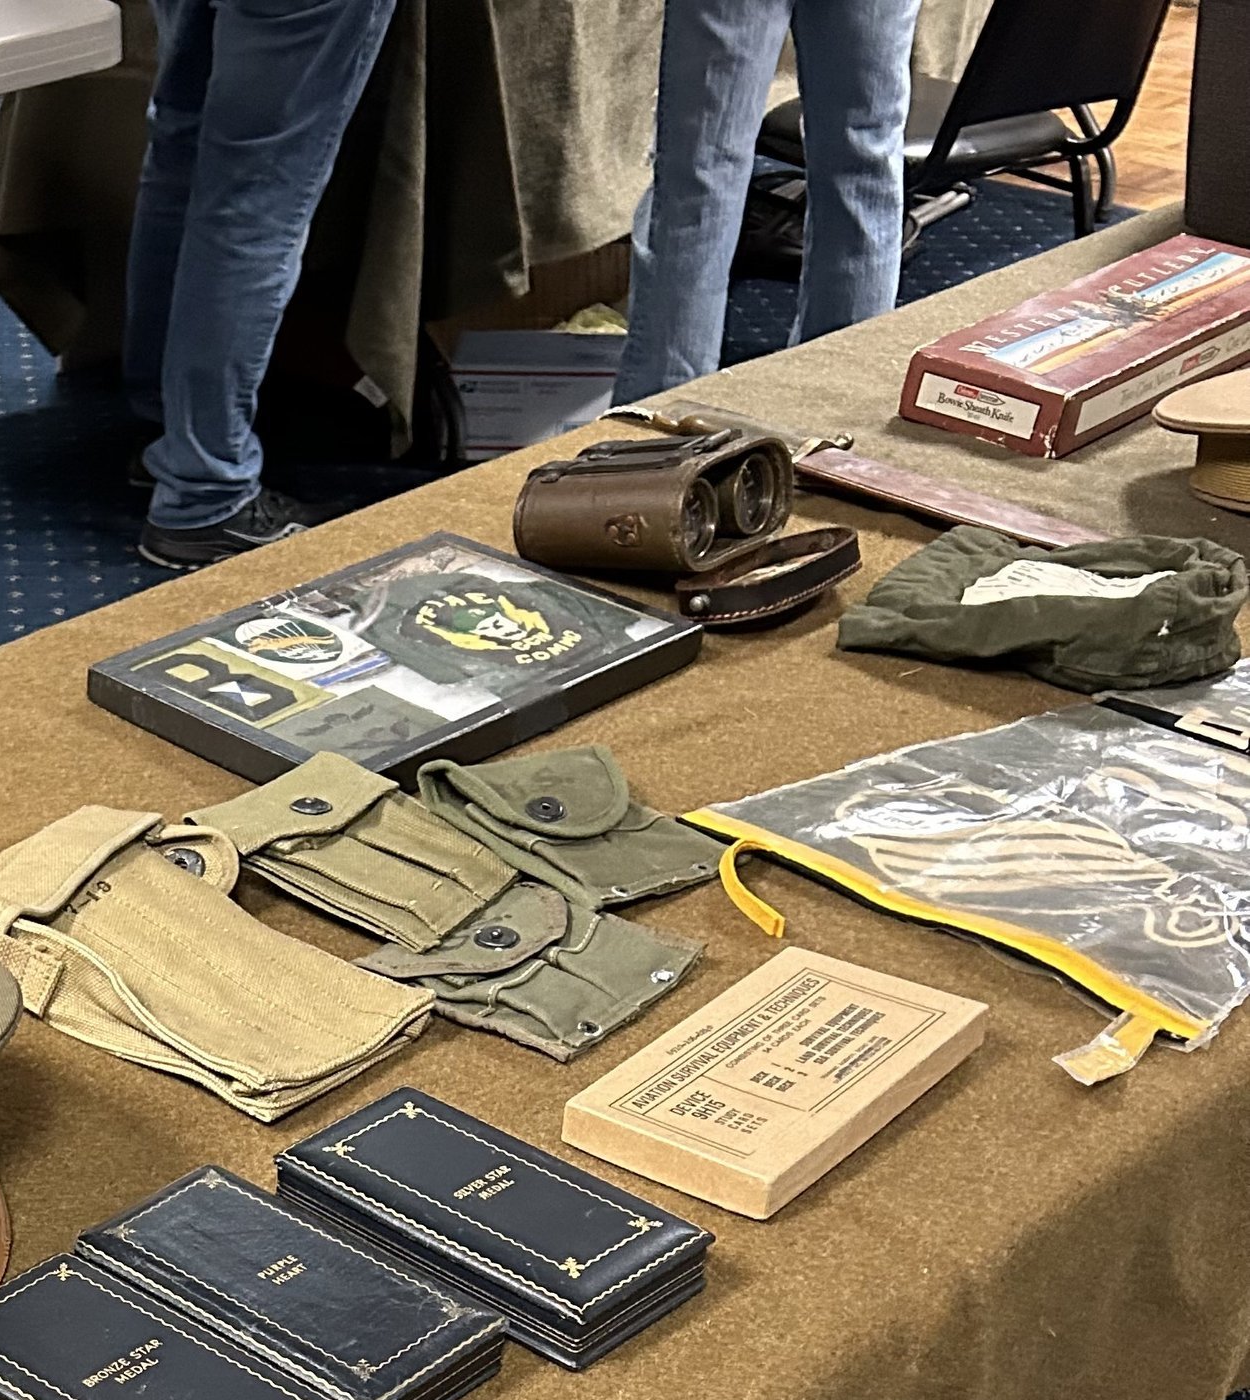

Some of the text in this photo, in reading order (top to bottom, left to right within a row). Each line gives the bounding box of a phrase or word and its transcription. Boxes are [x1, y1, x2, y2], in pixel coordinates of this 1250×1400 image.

[1108, 247, 1216, 303] CUTLERY
[964, 400, 991, 416] Sheath
[991, 408, 1014, 422] Knife
[631, 1079, 678, 1109] AVIATION
[670, 1051, 719, 1082] SURVIVAL
[710, 1018, 763, 1053] EQUIPMENT
[764, 978, 820, 1015] TECHNIQUES
[762, 1034, 772, 1042] OF
[668, 1090, 712, 1116] DEVICE
[691, 1099, 726, 1120] 9H15
[714, 1108, 741, 1125] STUDY
[727, 1113, 754, 1130] CARD
[740, 1117, 768, 1134] SETS
[453, 1165, 512, 1200] SILVER STAR
[478, 1179, 515, 1200] MEDAL
[257, 1254, 299, 1280] PURPLE
[271, 1263, 308, 1285] HEART
[82, 1339, 164, 1388] BRONZE STAR
[114, 1358, 159, 1384] MEDAL
